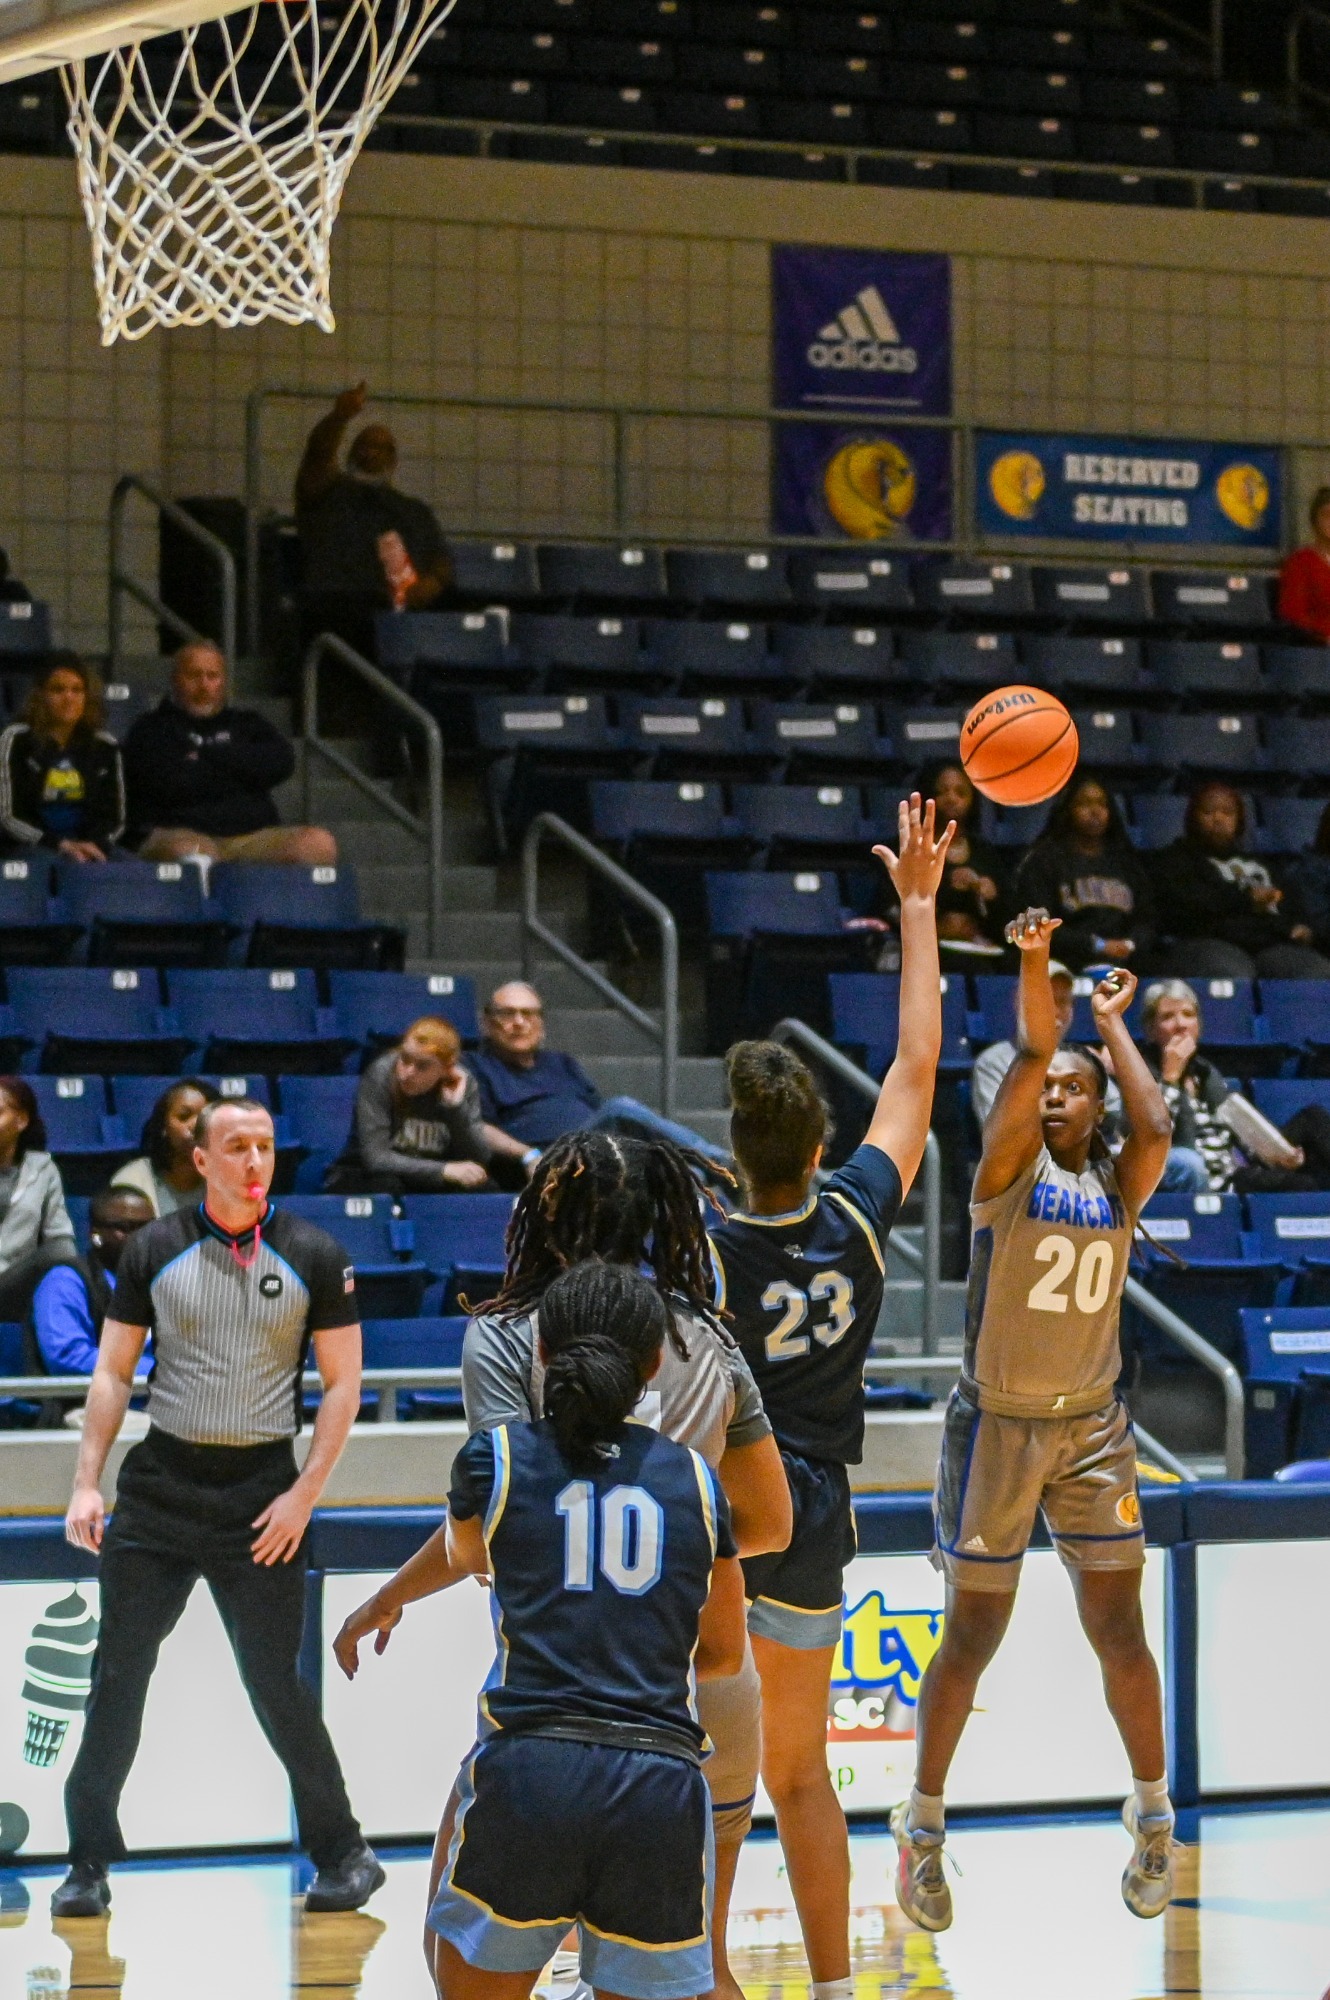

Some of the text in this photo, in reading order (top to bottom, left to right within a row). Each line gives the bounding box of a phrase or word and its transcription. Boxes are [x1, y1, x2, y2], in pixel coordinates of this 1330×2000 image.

[806, 341, 918, 374] adidas
[1064, 453, 1200, 489] RESERVED
[1074, 493, 1188, 527] SEATING
[967, 693, 1036, 735] Wilson
[265, 1280, 280, 1290] JOE
[1027, 1235, 1113, 1314] 20
[761, 1270, 856, 1361] 23
[555, 1480, 664, 1596] 10
